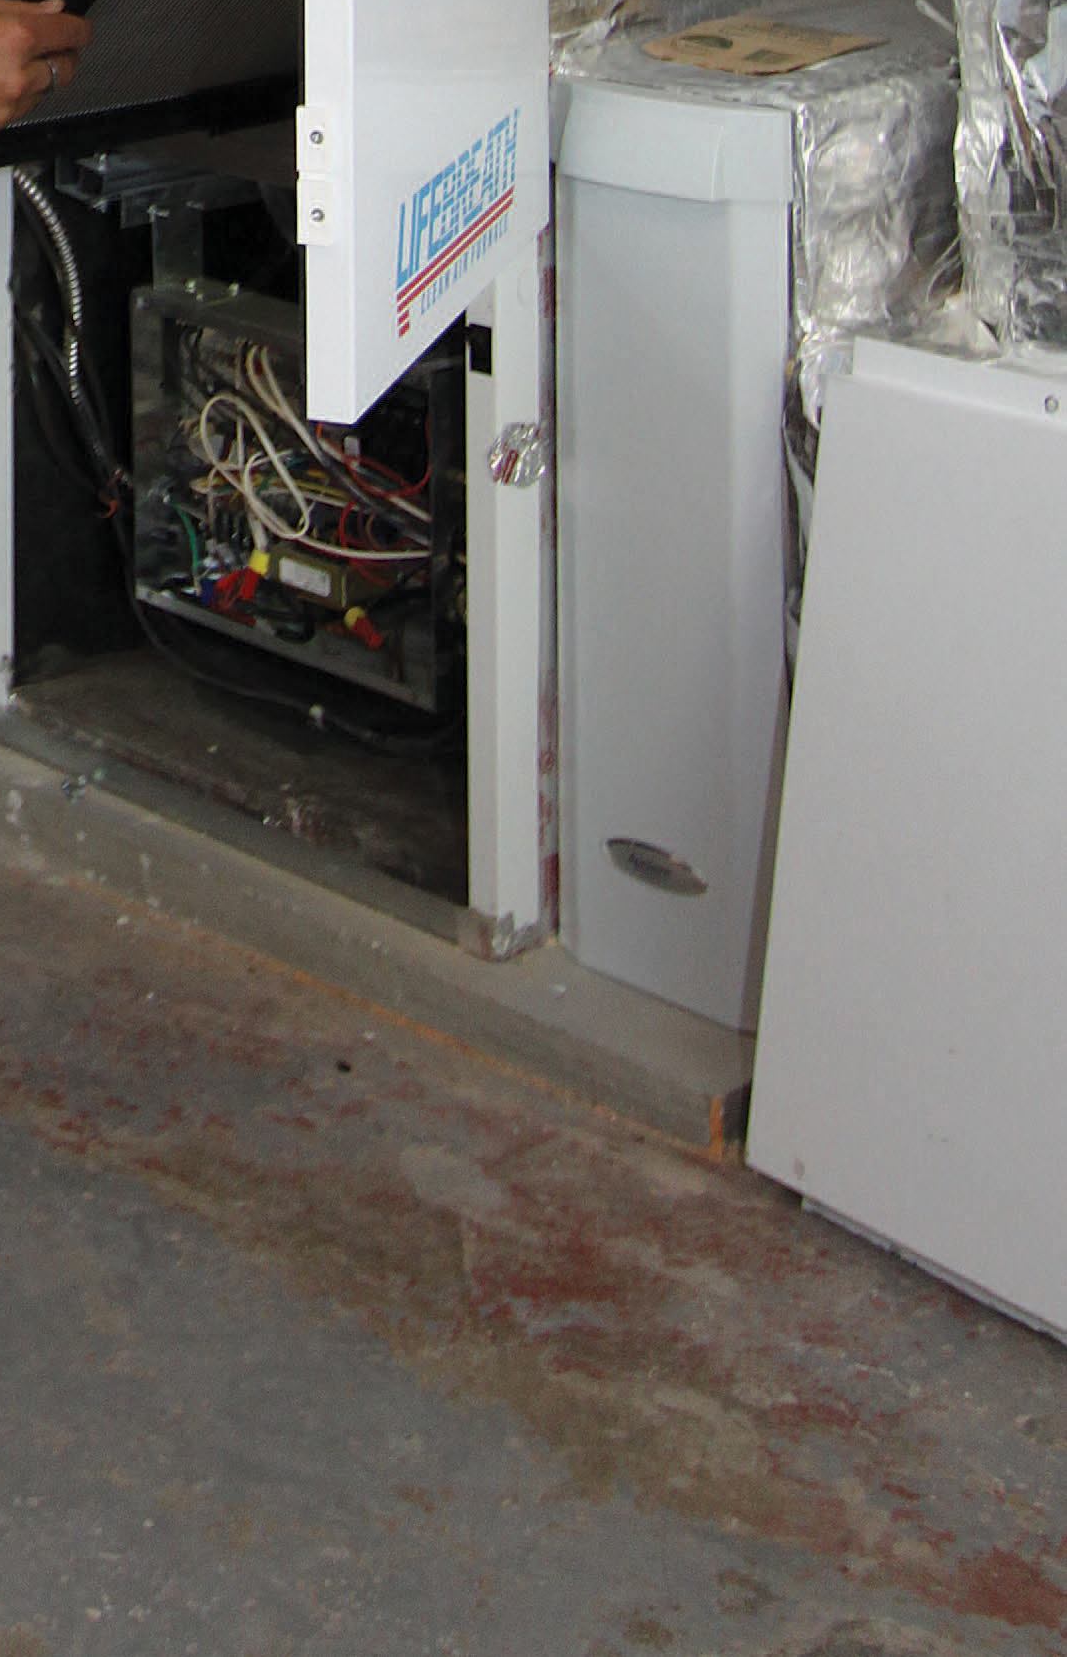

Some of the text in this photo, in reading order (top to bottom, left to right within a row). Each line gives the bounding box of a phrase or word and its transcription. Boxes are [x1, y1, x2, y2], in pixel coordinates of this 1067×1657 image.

[396, 107, 519, 290] LIFEBREATH
[420, 270, 450, 315] CLEAN
[453, 248, 469, 280] AIR
